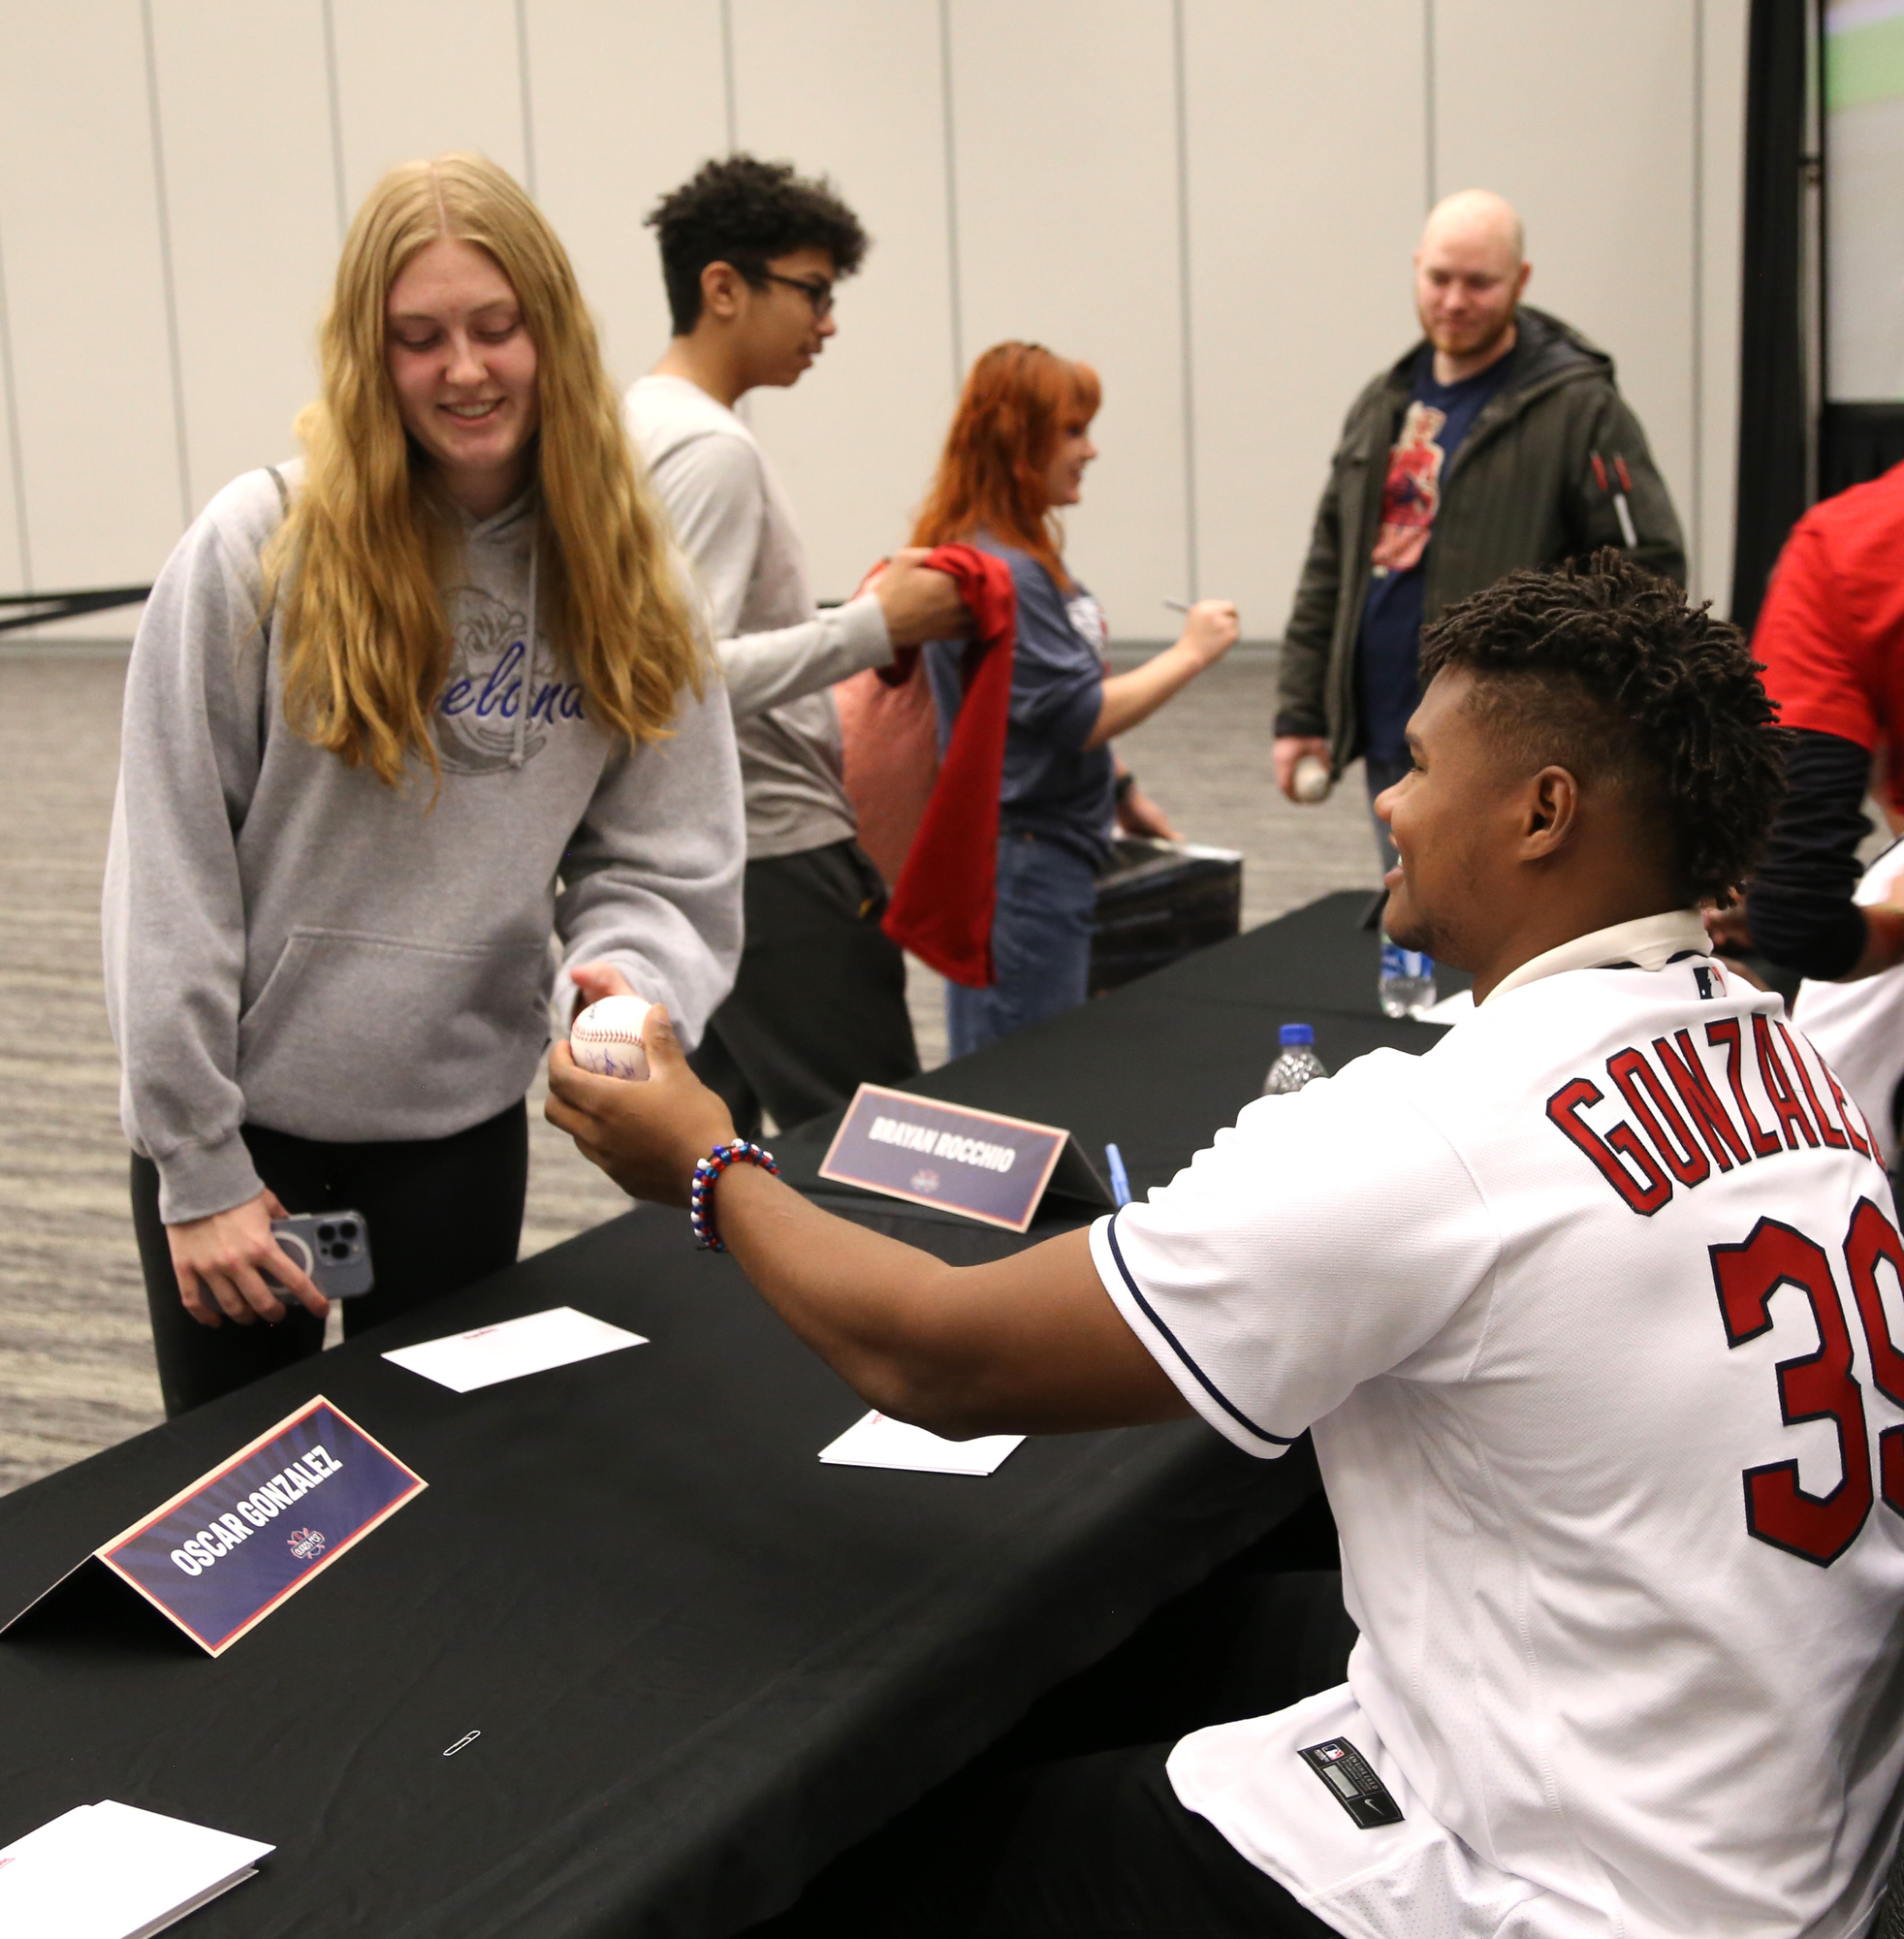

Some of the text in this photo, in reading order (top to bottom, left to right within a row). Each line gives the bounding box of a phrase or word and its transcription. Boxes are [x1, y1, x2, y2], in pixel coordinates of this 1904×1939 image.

[869, 1116, 1017, 1174] BRAYAN ROCCHIO
[1545, 1012, 1888, 1218] GONZALE
[170, 1445, 344, 1576] OSCAR GONZALEZ
